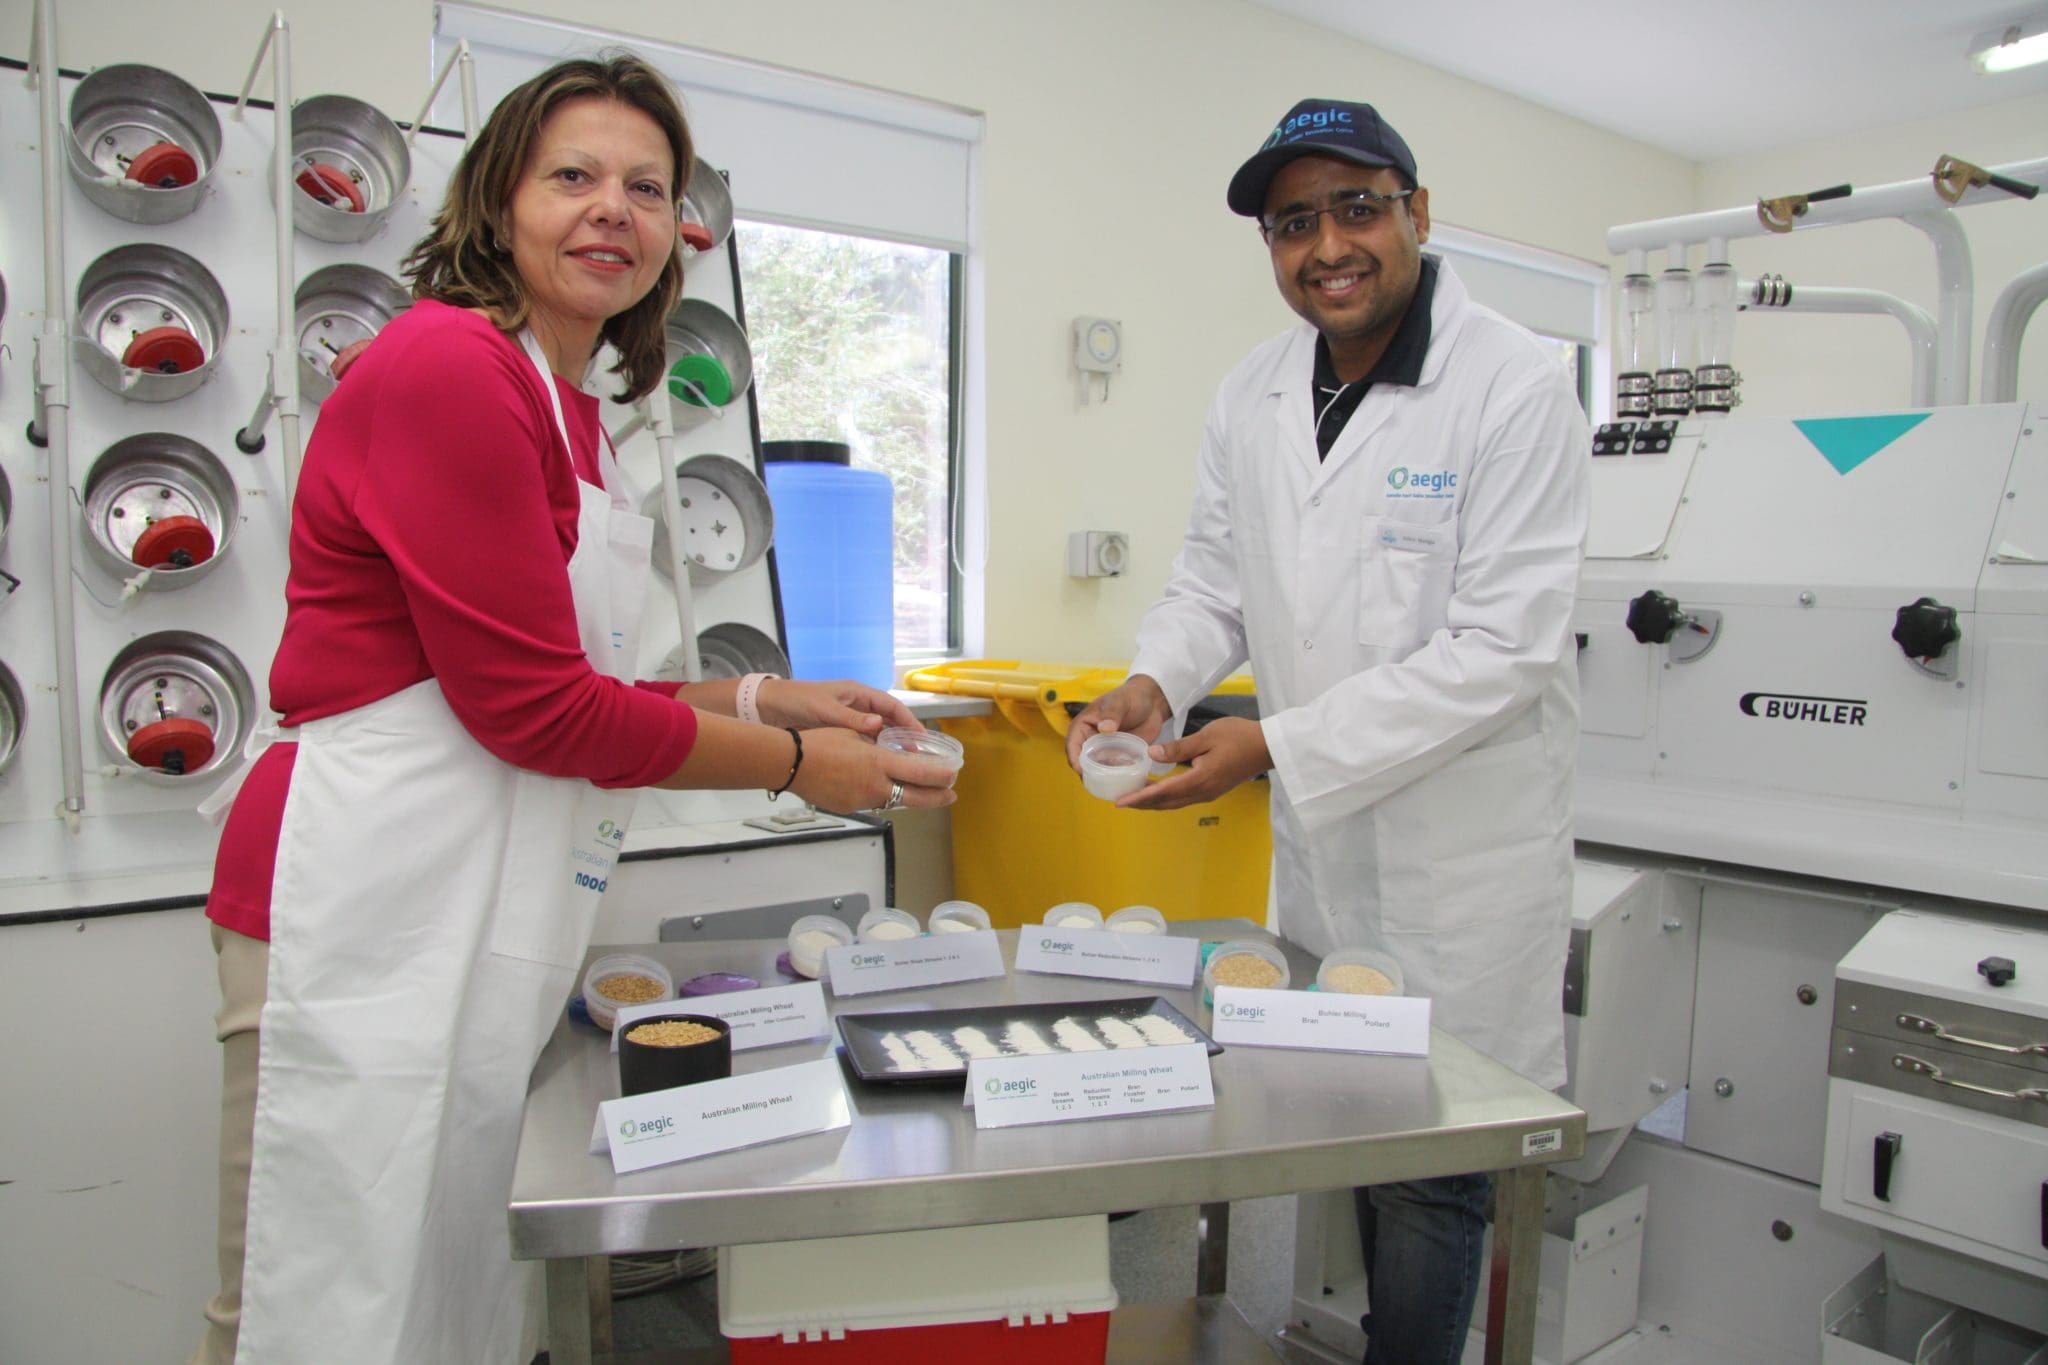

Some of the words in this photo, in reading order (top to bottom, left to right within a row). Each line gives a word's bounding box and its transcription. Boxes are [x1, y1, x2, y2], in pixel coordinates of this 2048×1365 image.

[1285, 108, 1352, 134] aegic
[1411, 470, 1457, 491] aegic
[1766, 700, 1867, 726] BÜHLER
[1053, 941, 1074, 951] aegic
[864, 955, 885, 965] aegic
[716, 1009, 749, 1020] Australian
[750, 1005, 772, 1014] Milling
[772, 1002, 794, 1011] Wheat
[1236, 1006, 1266, 1019] aegic
[1365, 1020, 1390, 1028] Pollard
[1081, 1071, 1120, 1081] Australian
[1121, 1069, 1147, 1077] Milling
[1148, 1066, 1174, 1075] Wheat
[1004, 1076, 1037, 1093] aegic
[701, 1105, 741, 1120] Australian
[741, 1099, 768, 1111] Milling
[768, 1095, 793, 1105] Wheat
[640, 1116, 674, 1133] aegic
